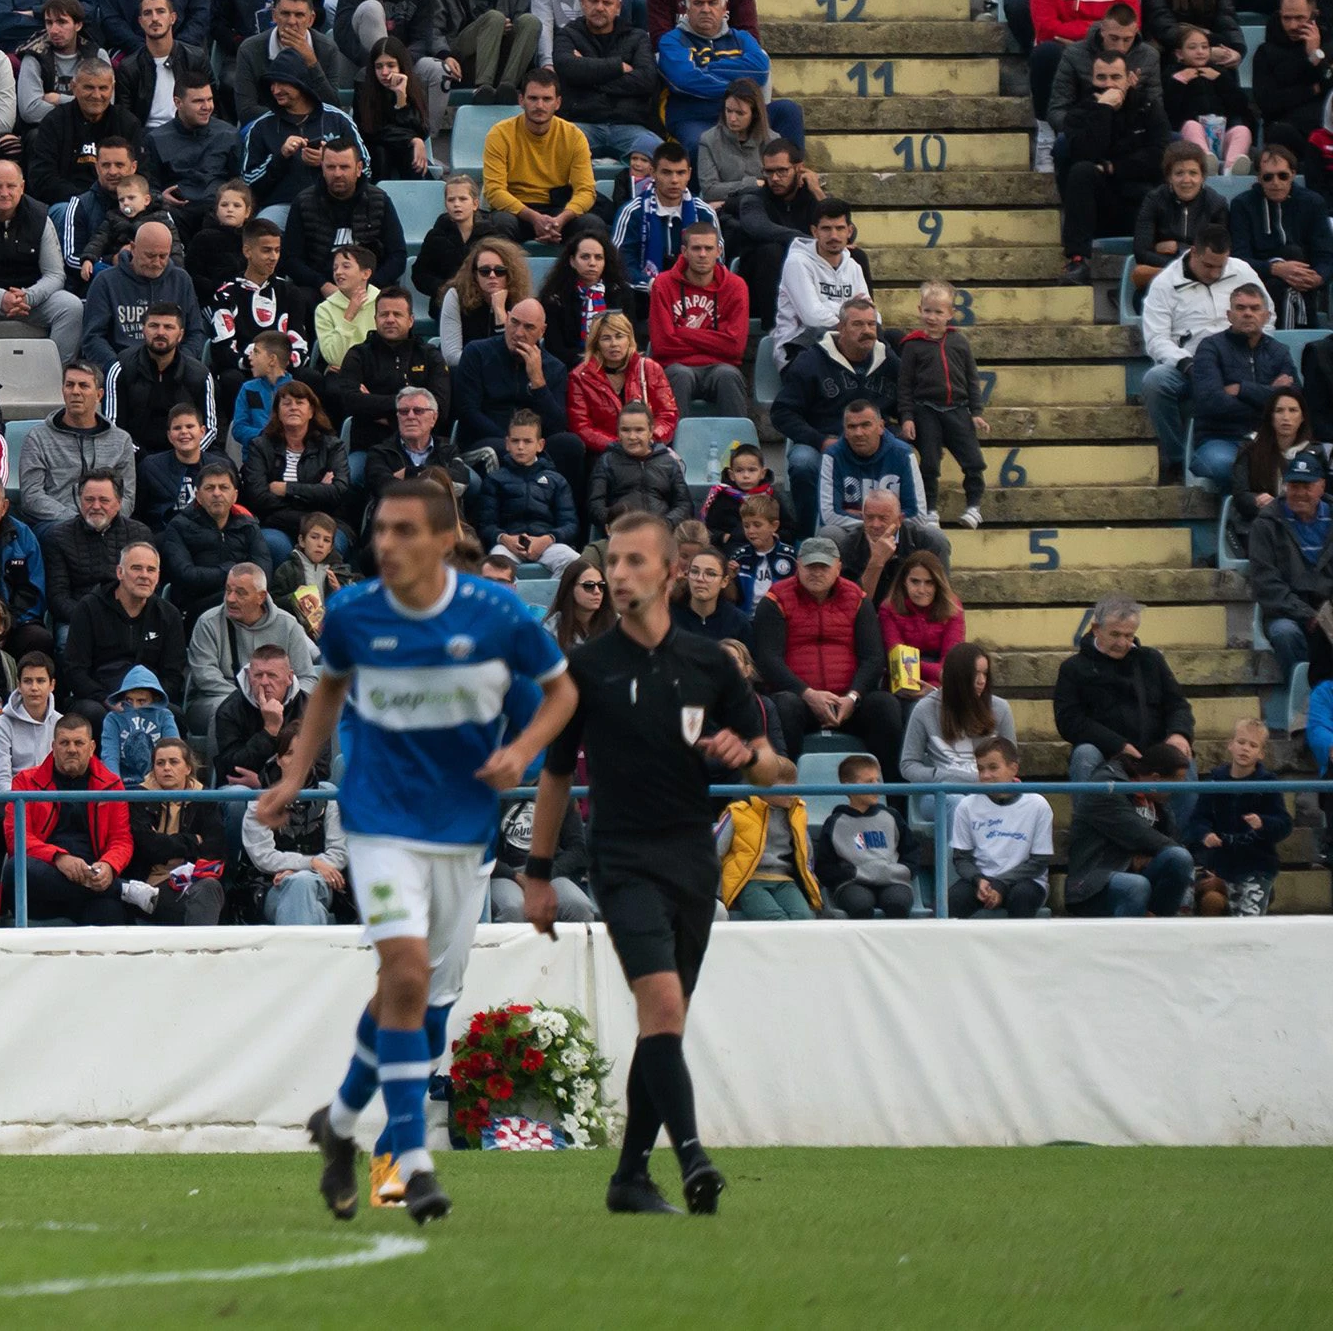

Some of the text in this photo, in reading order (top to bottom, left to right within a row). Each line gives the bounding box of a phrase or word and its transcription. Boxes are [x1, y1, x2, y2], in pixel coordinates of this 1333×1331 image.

[847, 61, 893, 97] 11
[893, 134, 947, 172] 10
[918, 211, 943, 248] 9
[999, 448, 1027, 488] 6
[1028, 529, 1060, 570] 5
[862, 830, 888, 849] NBA
